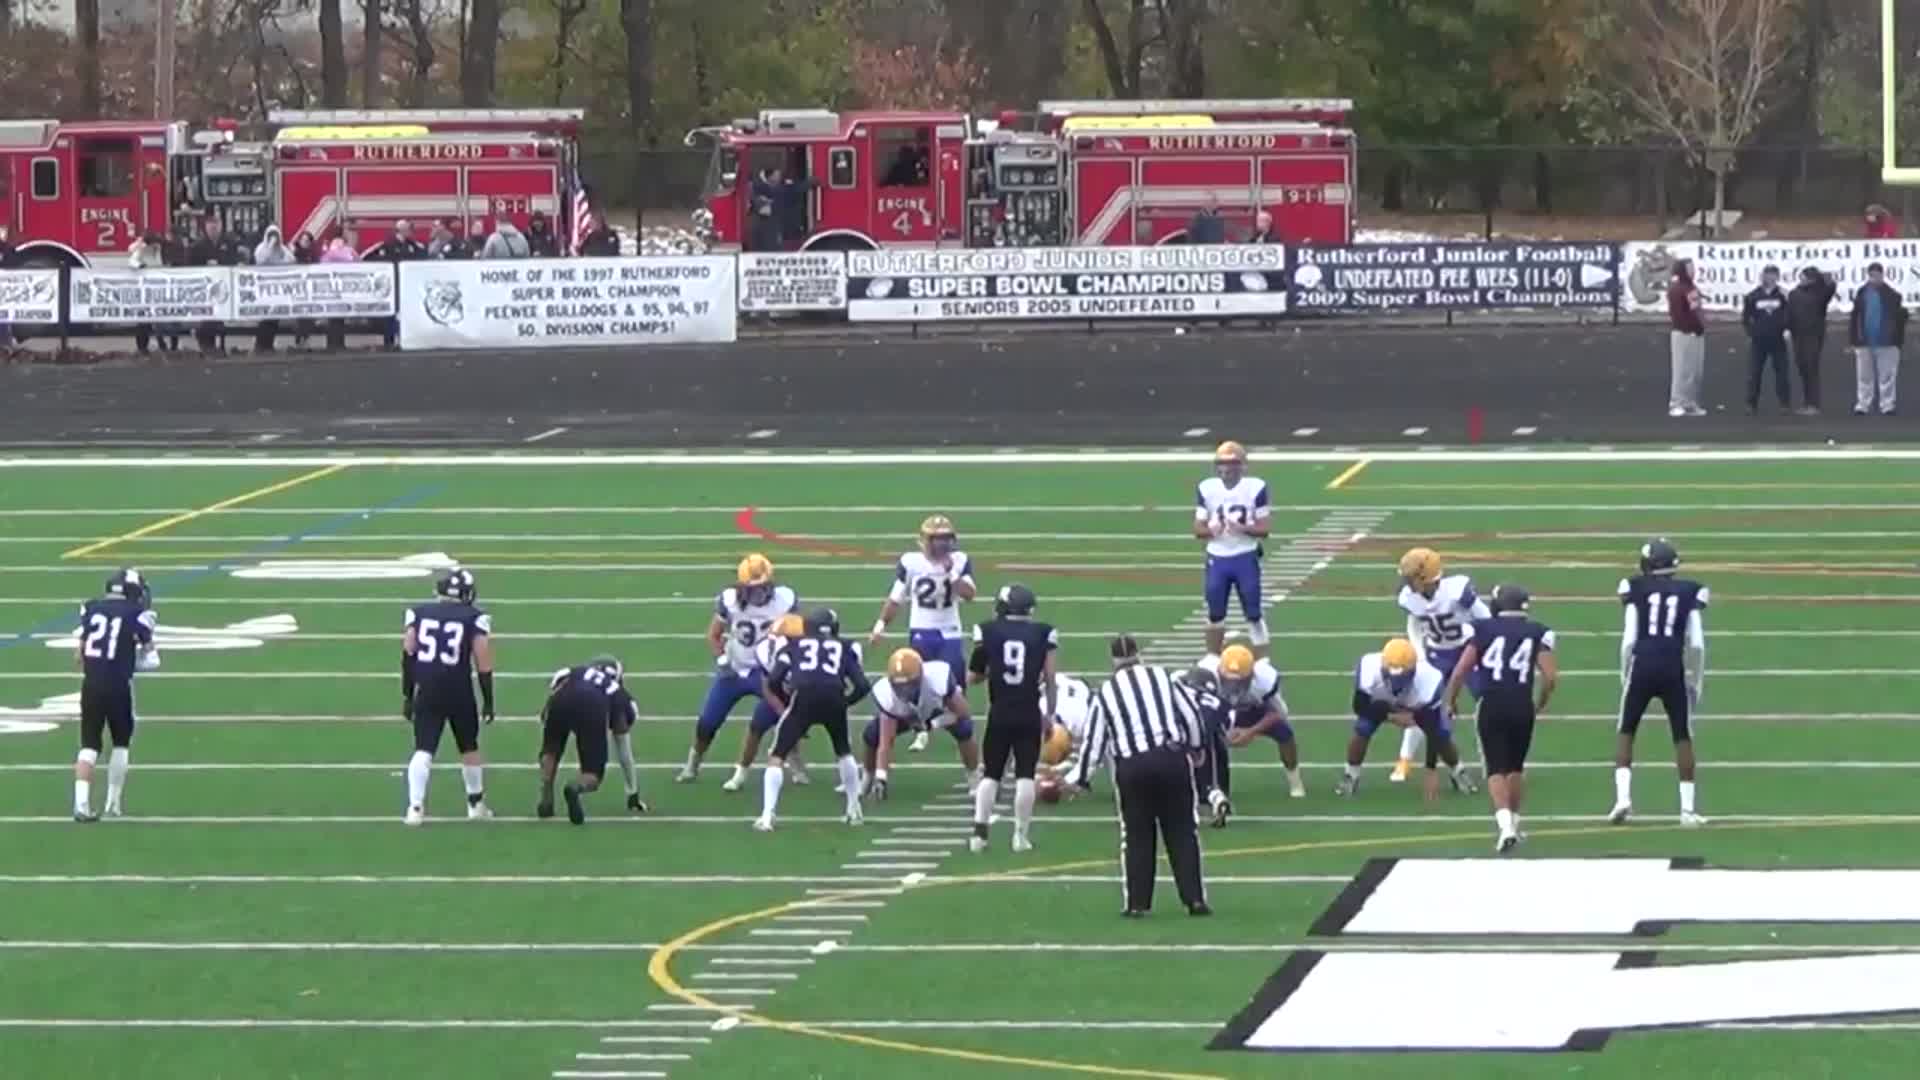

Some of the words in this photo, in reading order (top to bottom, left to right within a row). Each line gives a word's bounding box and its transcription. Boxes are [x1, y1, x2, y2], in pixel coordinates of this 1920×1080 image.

[354, 144, 483, 159] RUTHERFORD
[1150, 134, 1277, 150] RUTHERFORD
[877, 198, 926, 213] ENGINE
[81, 208, 129, 224] ENGINE
[892, 211, 912, 235] 4
[97, 224, 116, 246] 2
[854, 251, 1026, 273] RUTHERFORD
[1034, 249, 1131, 271] JUNIOR
[1143, 247, 1279, 269] BULLDOGS
[1297, 247, 1426, 265] Rutherford
[1432, 246, 1509, 265] Junior
[1516, 245, 1612, 263] Football
[1698, 244, 1851, 260] Rutherford
[481, 269, 519, 283] HOME
[527, 269, 543, 282] OF
[552, 268, 576, 282] THE
[583, 267, 613, 281] 1997
[620, 266, 710, 280] RUTHERFORD
[1334, 268, 1434, 289] UNDEFEATED
[1440, 267, 1470, 288] PEE
[1476, 267, 1518, 288] WEES
[1697, 267, 1737, 283] 2012
[512, 286, 555, 301] SUPER
[562, 286, 601, 300] BOWL
[607, 284, 680, 298] CHAMPION
[908, 277, 987, 298] SUPER
[995, 275, 1068, 296] BOWL
[1076, 273, 1225, 294] CHAMPIONS
[941, 302, 1019, 315] SENIORS
[1027, 300, 1071, 314] 2005
[1079, 298, 1195, 313] UNDEFEATED
[1296, 291, 1347, 306] 2009
[1352, 290, 1418, 308] Super
[1425, 289, 1480, 305] Bowl
[1486, 289, 1612, 308] Champions
[485, 303, 537, 320] PEEWEE
[546, 303, 617, 318] BULLDOGS
[624, 302, 635, 316] &
[546, 322, 604, 336] DIVISION
[610, 321, 675, 335] CHAMPS!
[915, 577, 954, 609] 21
[1648, 592, 1679, 637] 11
[84, 613, 123, 660] 21
[416, 618, 465, 666] 53
[798, 638, 843, 676] 33
[1002, 639, 1027, 686] 9
[1481, 636, 1535, 684] 44
